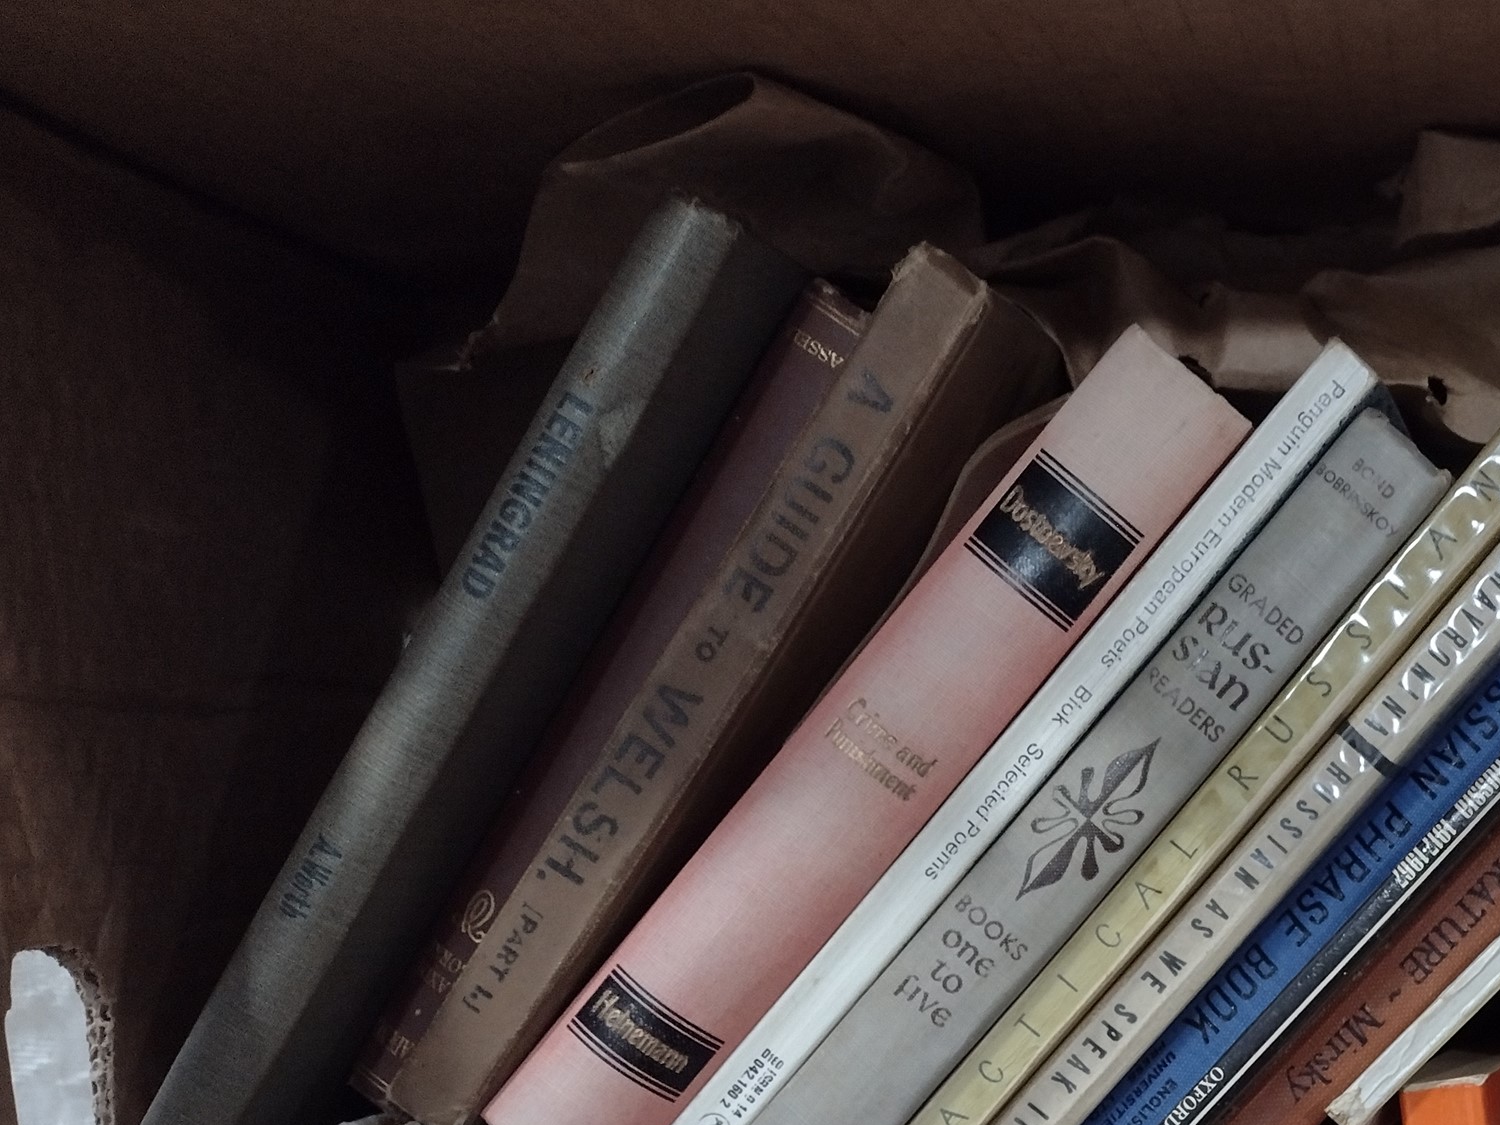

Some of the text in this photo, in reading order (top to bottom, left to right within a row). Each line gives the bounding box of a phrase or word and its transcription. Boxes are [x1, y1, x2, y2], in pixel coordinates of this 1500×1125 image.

[846, 369, 894, 416] A
[461, 390, 594, 600] LENINGRAD
[723, 435, 856, 614] GUIDE
[694, 624, 732, 664] TO
[924, 379, 1347, 882] Penguin Modern European Poets Blok Selected Poems
[1227, 572, 1304, 646] GRADED
[848, 697, 940, 779] Crime and
[1151, 667, 1226, 744] READERS
[1232, 758, 1351, 893] RUSSIAN
[1196, 896, 1231, 939] AS
[1281, 800, 1413, 952] PHRASE
[954, 894, 1030, 962] BOOKS
[1140, 950, 1188, 996] WE
[1182, 945, 1281, 1046] BOOK
[594, 988, 690, 1075] Heinemann
[1050, 1001, 1139, 1095] SPEAK
[1287, 1006, 1387, 1099] Mirsky
